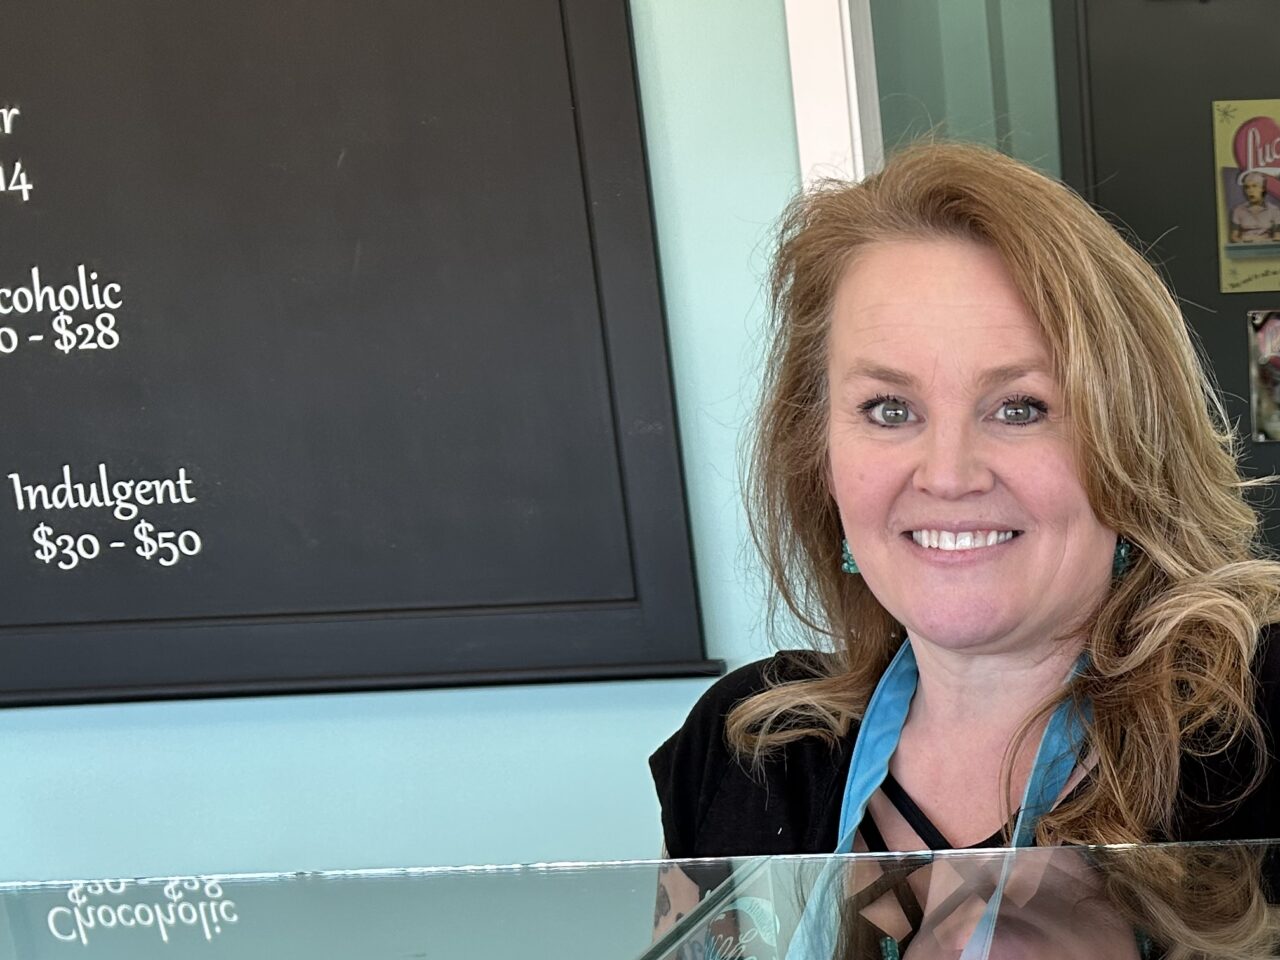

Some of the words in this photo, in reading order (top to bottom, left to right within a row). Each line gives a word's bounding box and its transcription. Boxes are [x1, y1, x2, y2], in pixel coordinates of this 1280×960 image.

[0, 107, 20, 134] r
[52, 310, 120, 354] $28
[8, 463, 197, 521] Indulgent
[32, 521, 101, 570] $30
[133, 519, 202, 568] $50
